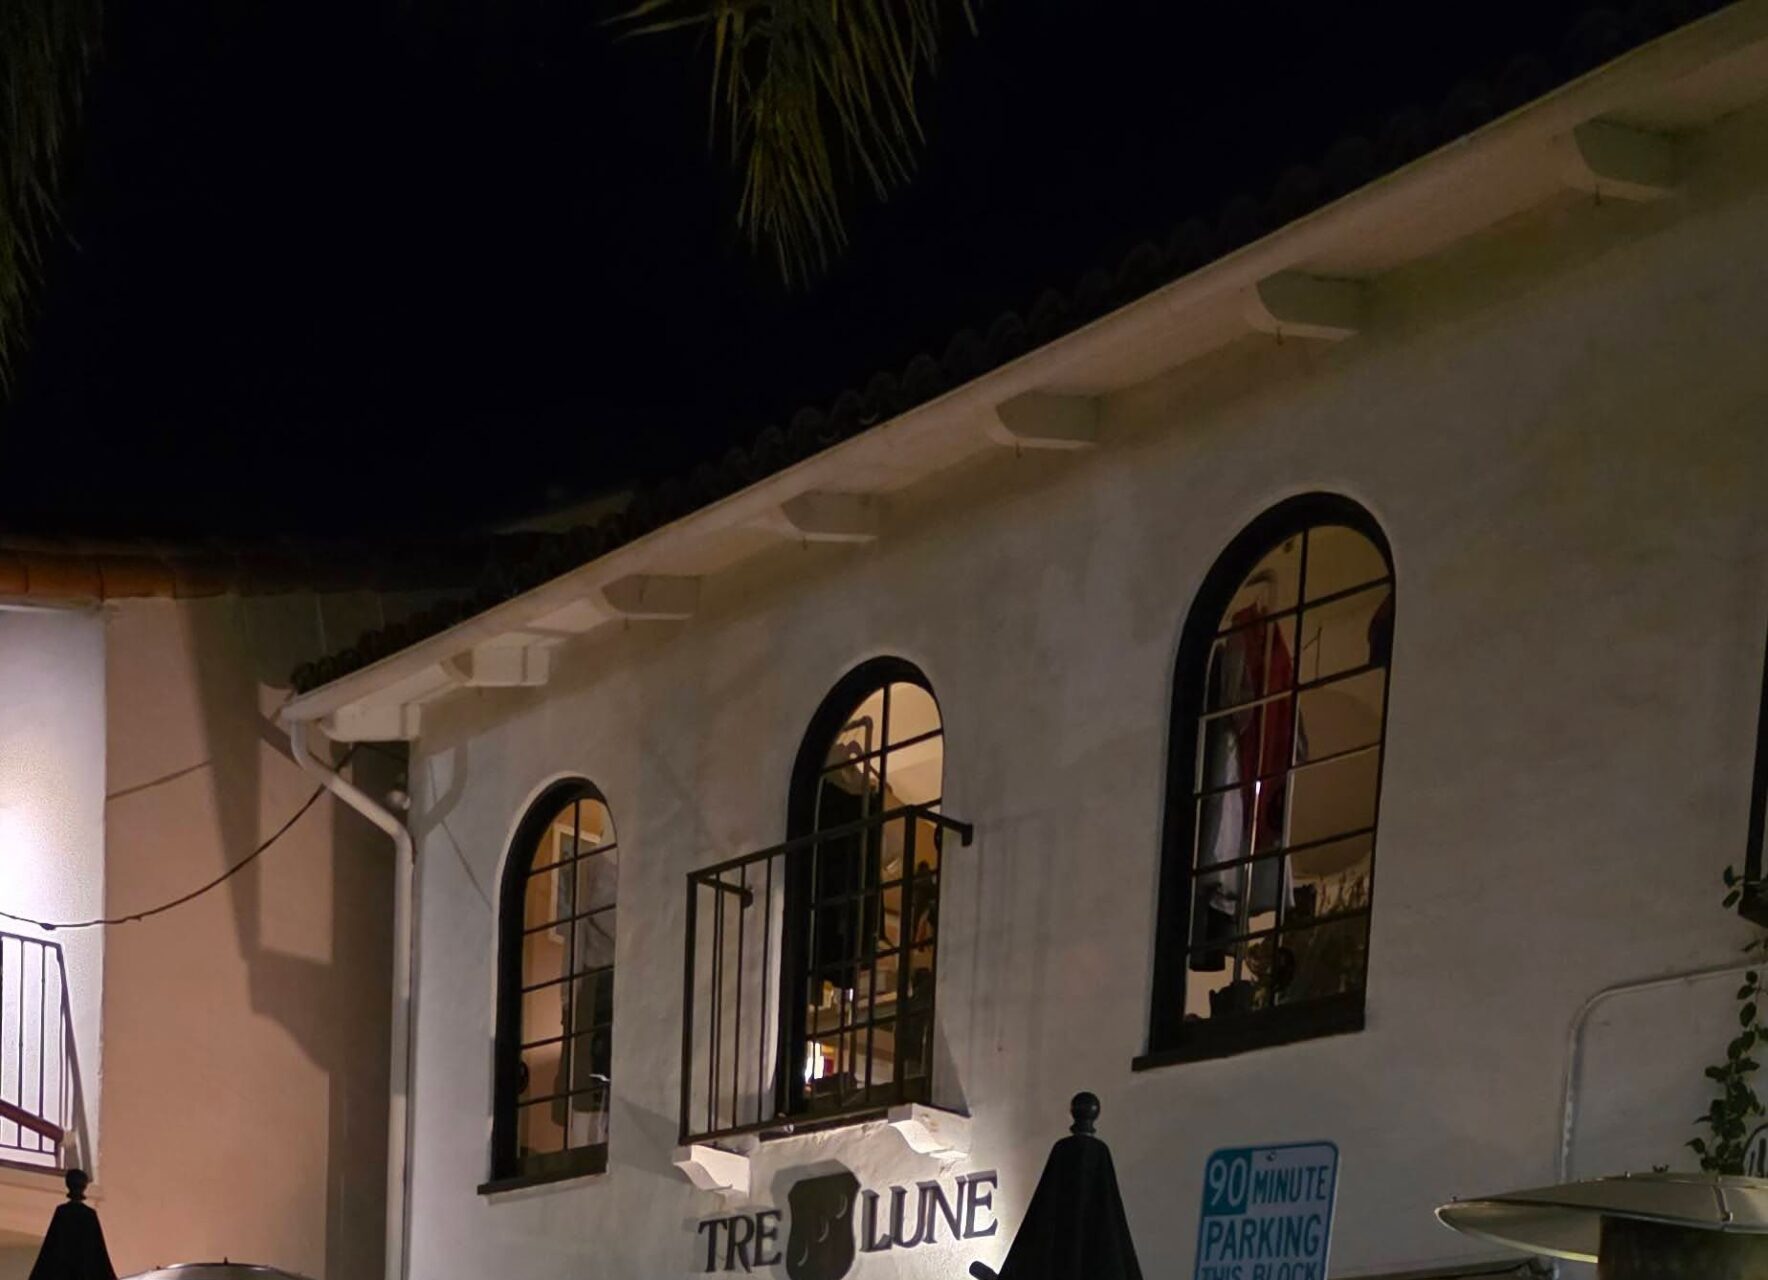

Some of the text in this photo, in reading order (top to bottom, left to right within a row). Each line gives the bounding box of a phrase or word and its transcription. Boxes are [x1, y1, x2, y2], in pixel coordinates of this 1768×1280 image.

[1208, 1157, 1330, 1207] 90 MINUTE
[698, 1170, 998, 1273] TRE LUNE
[1204, 1214, 1322, 1261] PARKING
